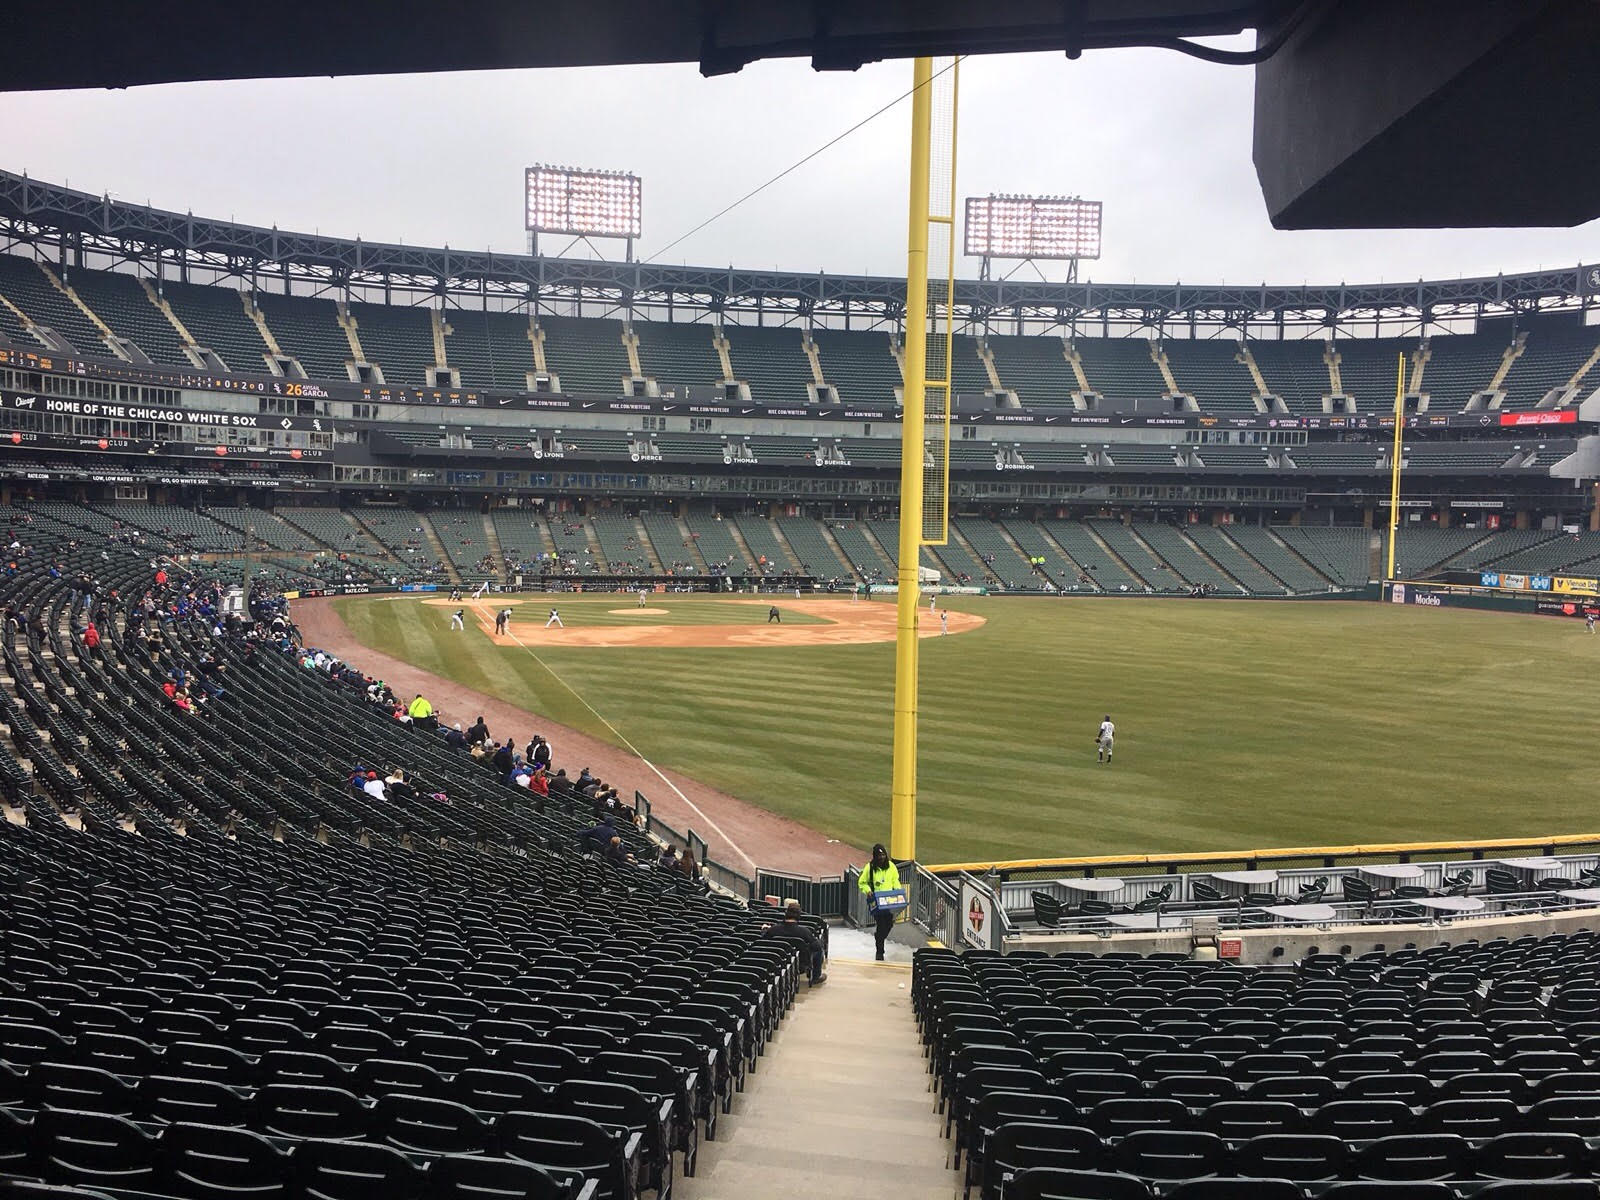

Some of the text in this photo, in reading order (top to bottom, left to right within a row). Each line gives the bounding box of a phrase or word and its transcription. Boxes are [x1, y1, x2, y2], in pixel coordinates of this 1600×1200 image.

[286, 383, 302, 396] 26
[302, 389, 329, 398] GARCIA
[46, 400, 257, 427] HOME OF THE CHICAGO WHITE SOX
[1415, 593, 1441, 606] Modelo
[967, 928, 986, 950] ENTRANCE
